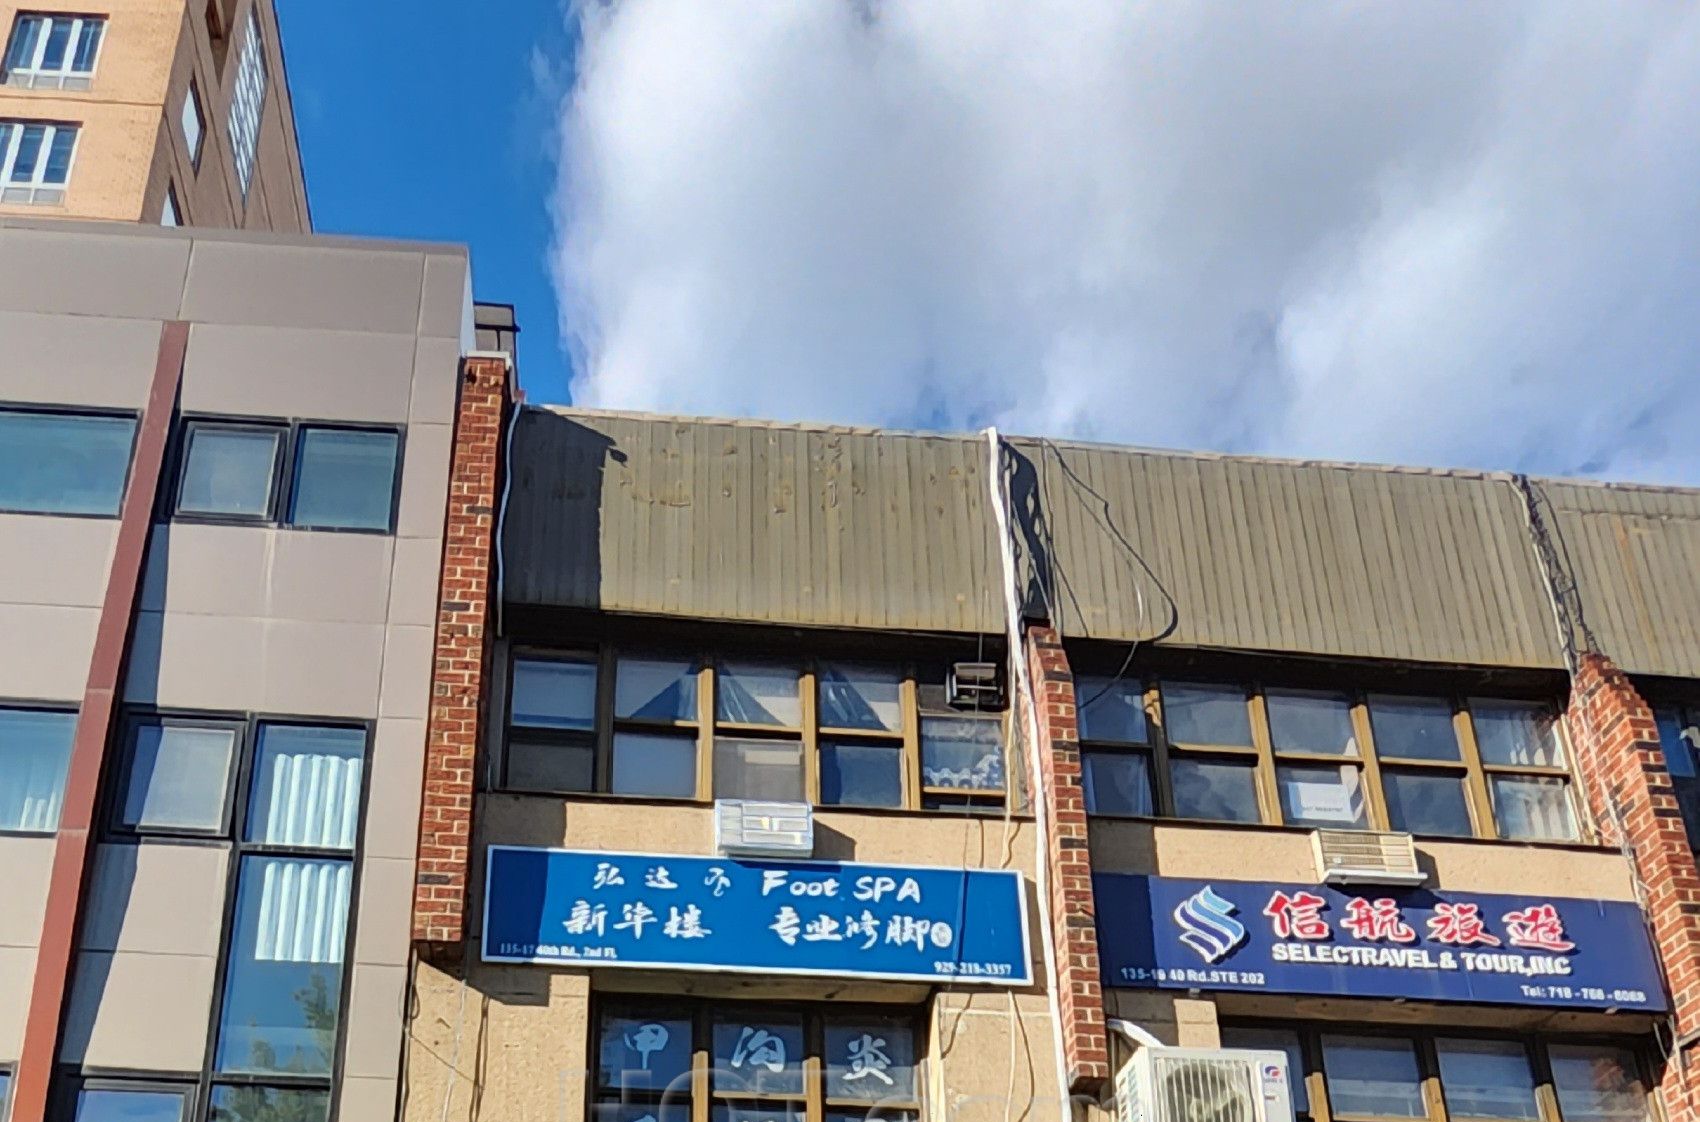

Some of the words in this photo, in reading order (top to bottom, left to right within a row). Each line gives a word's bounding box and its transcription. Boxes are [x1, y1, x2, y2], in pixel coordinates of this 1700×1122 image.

[762, 870, 840, 896] Foot
[853, 876, 920, 903] SPA
[1263, 890, 1576, 952] 信航旅遊
[1241, 972, 1266, 985] 202
